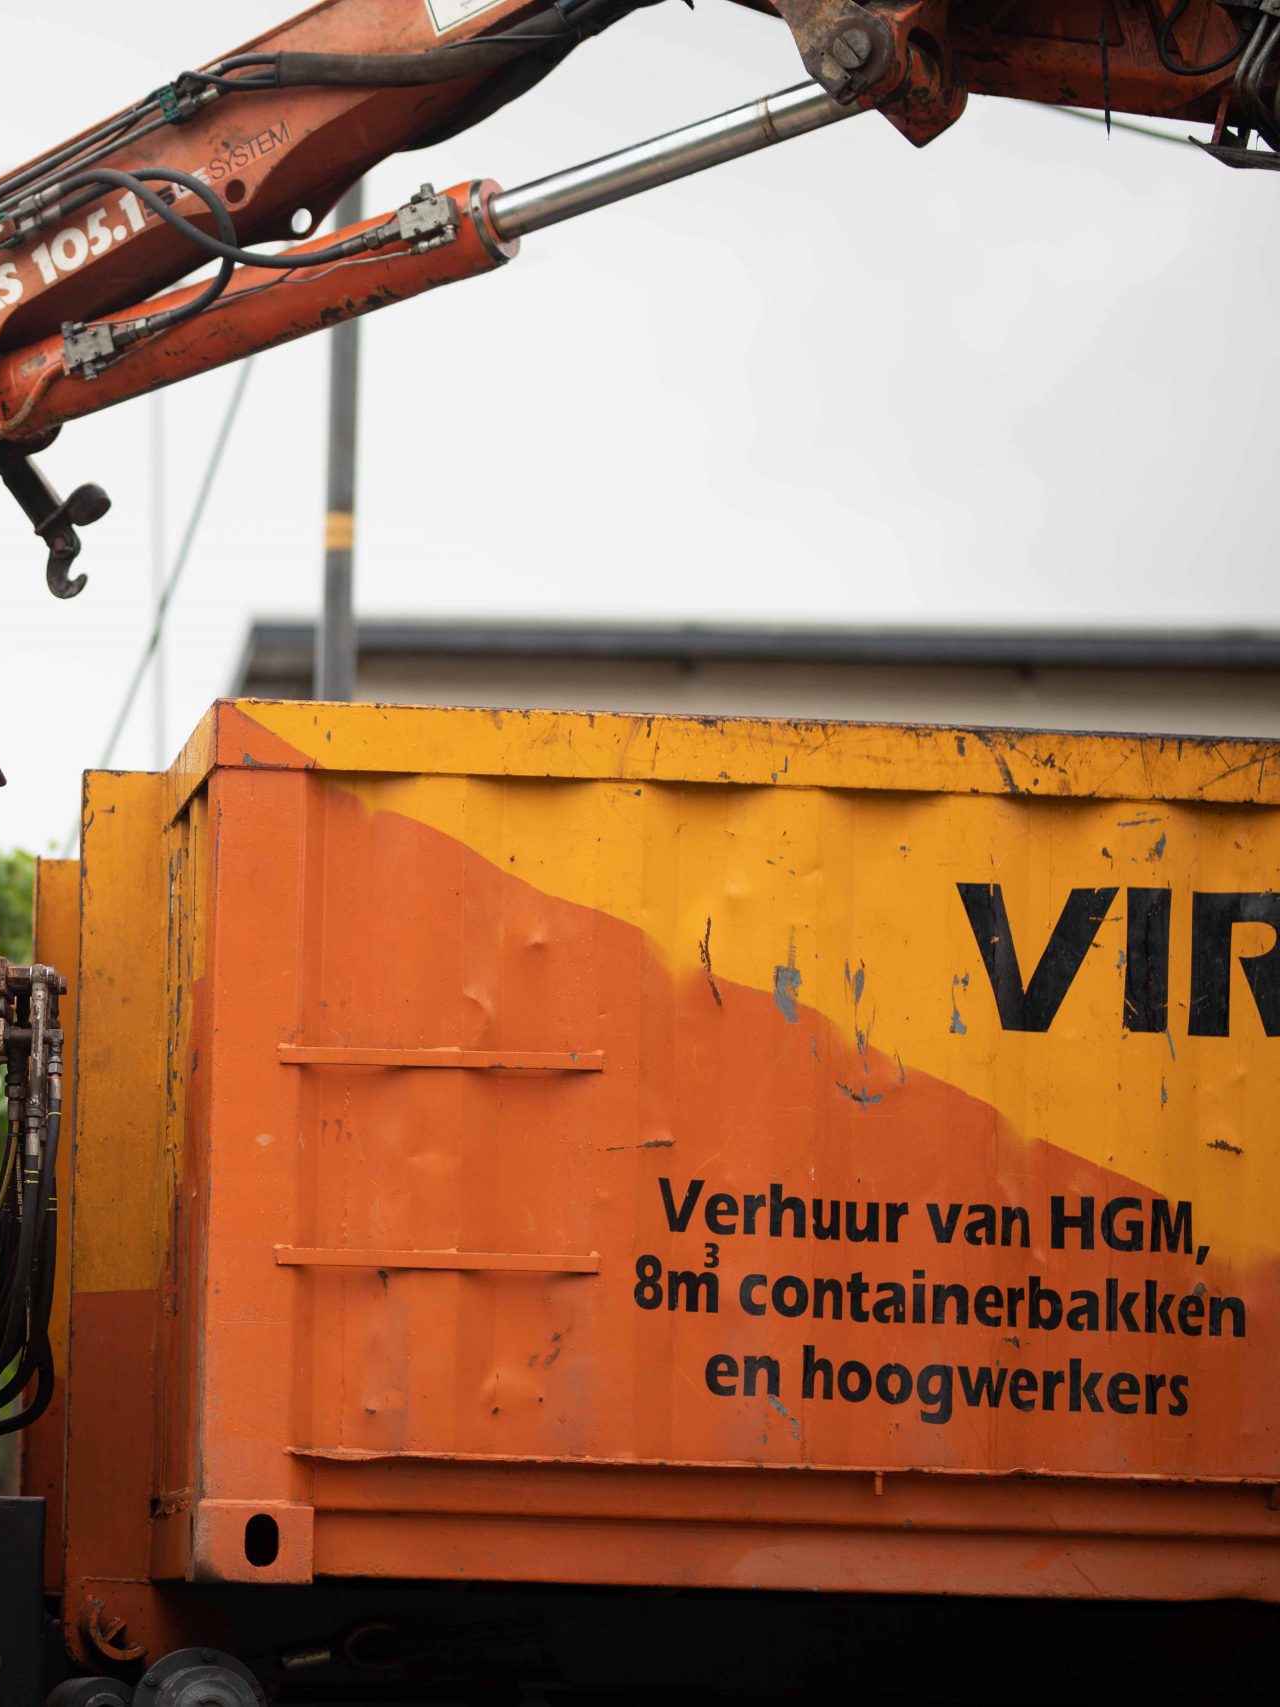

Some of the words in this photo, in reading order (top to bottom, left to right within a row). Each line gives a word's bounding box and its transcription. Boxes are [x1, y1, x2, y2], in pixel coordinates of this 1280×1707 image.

[209, 120, 290, 180] SYSTEM
[31, 190, 147, 286] 105.1
[955, 882, 1280, 1037] VIR
[658, 1176, 909, 1244] Verhuur
[926, 1202, 1030, 1247] van
[1049, 1194, 1211, 1266] HGM,
[738, 1269, 1247, 1338] containerbakken
[705, 1351, 781, 1399] en
[802, 1344, 1190, 1424] hoogwerkers
